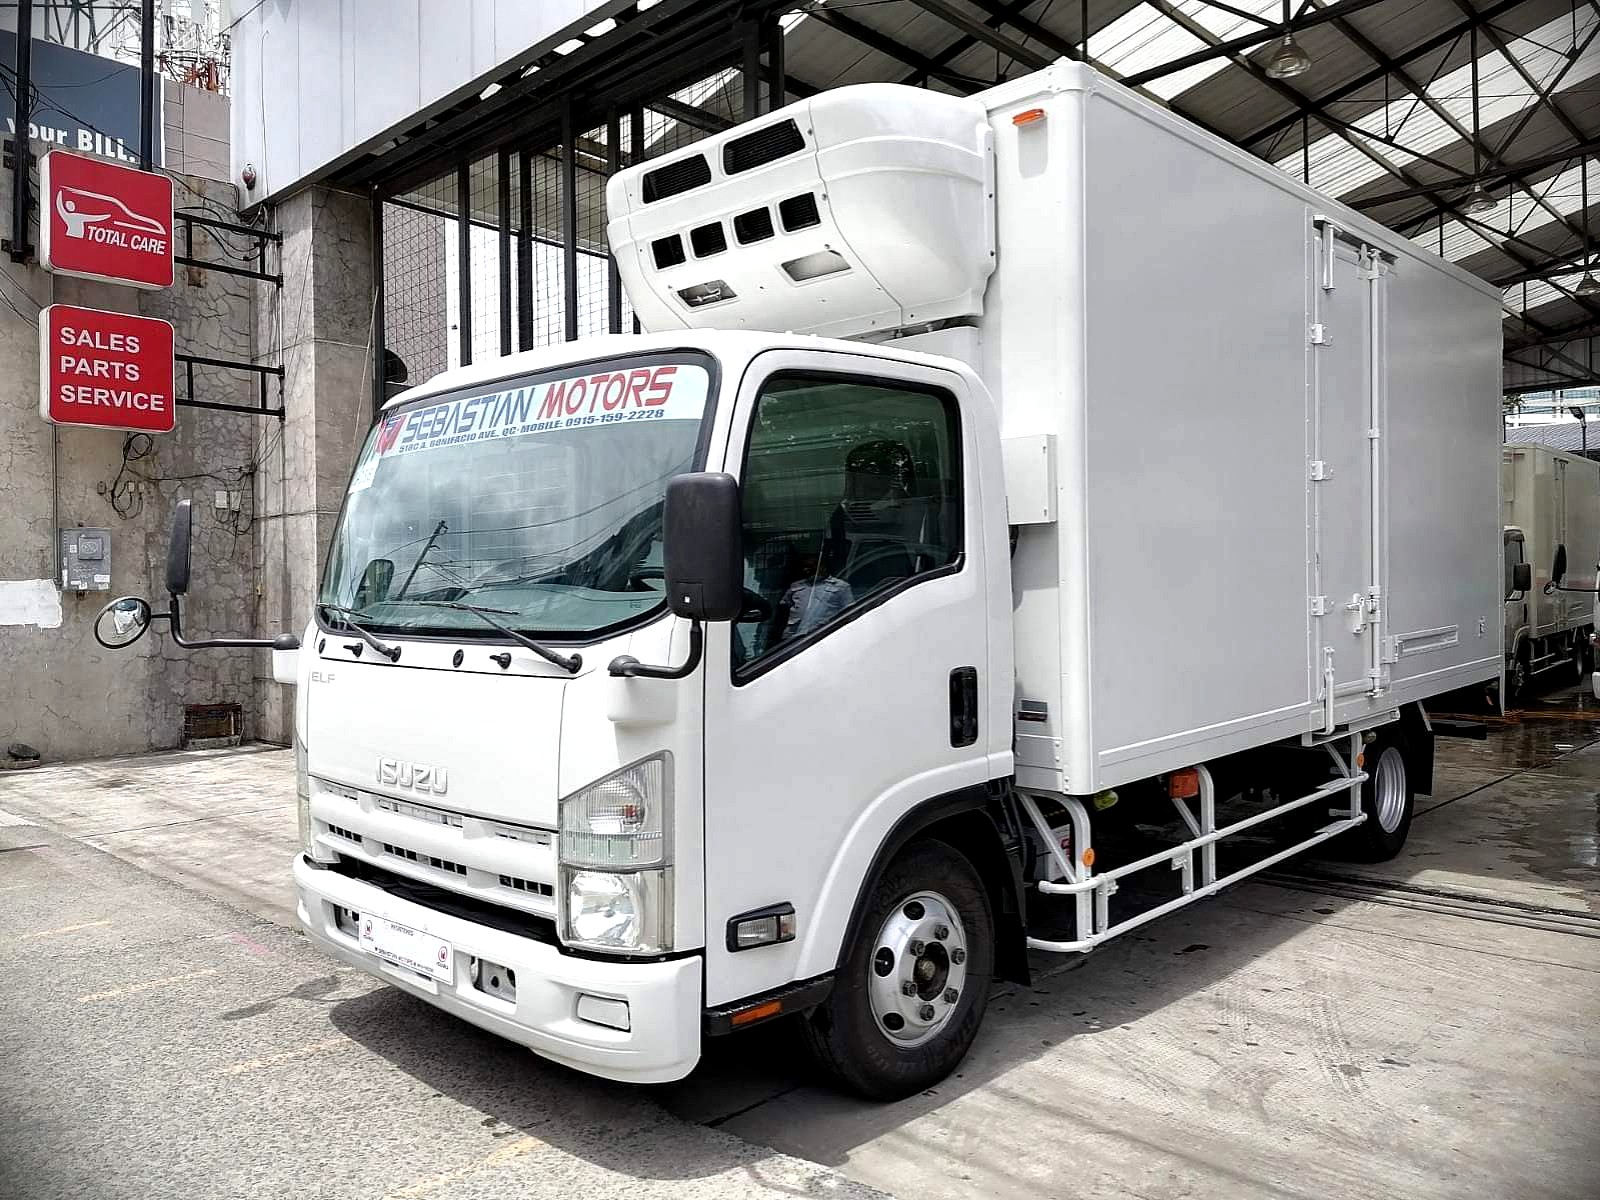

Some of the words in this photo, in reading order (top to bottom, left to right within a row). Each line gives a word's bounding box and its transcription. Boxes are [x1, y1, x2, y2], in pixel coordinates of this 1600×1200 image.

[77, 128, 137, 164] BILL.
[87, 225, 128, 248] TOTAL
[130, 235, 167, 255] CARE
[60, 326, 140, 354] SALES
[60, 355, 140, 381] PARTS
[60, 384, 165, 411] SERVICE
[402, 386, 536, 443] SEBASTIAN
[536, 366, 678, 420] MOTORS
[429, 432, 477, 448] BONIFACIO
[565, 408, 665, 427] 0915-159-2228
[311, 671, 336, 684] ELF
[375, 755, 449, 795] ISUZU
